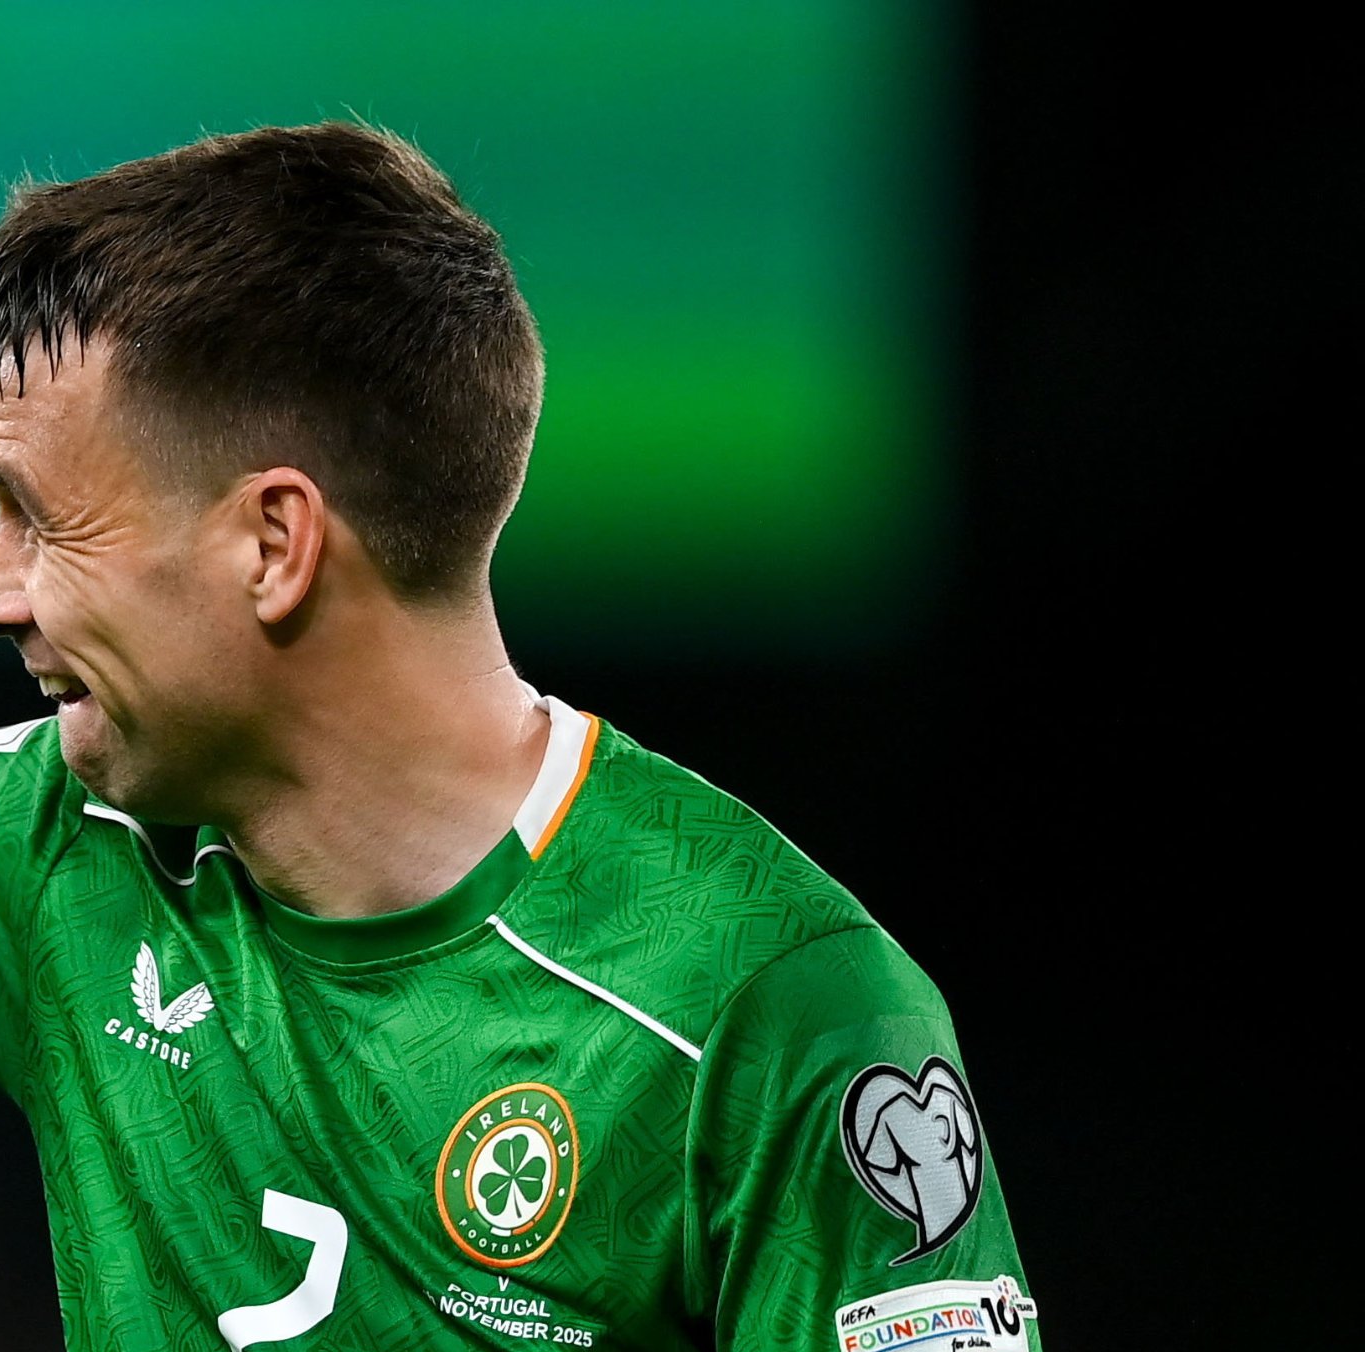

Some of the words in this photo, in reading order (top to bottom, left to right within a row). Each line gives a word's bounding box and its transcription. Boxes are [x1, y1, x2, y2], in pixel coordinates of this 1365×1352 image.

[104, 1018, 191, 1070] CASTORE
[465, 1097, 569, 1157] IRELAND
[458, 1217, 542, 1254] FOOTBALL
[440, 1296, 548, 1340] NOVEMBER
[552, 1326, 593, 1347] 2025
[447, 1283, 551, 1317] PORTUGAL
[841, 1305, 876, 1327] UEFA
